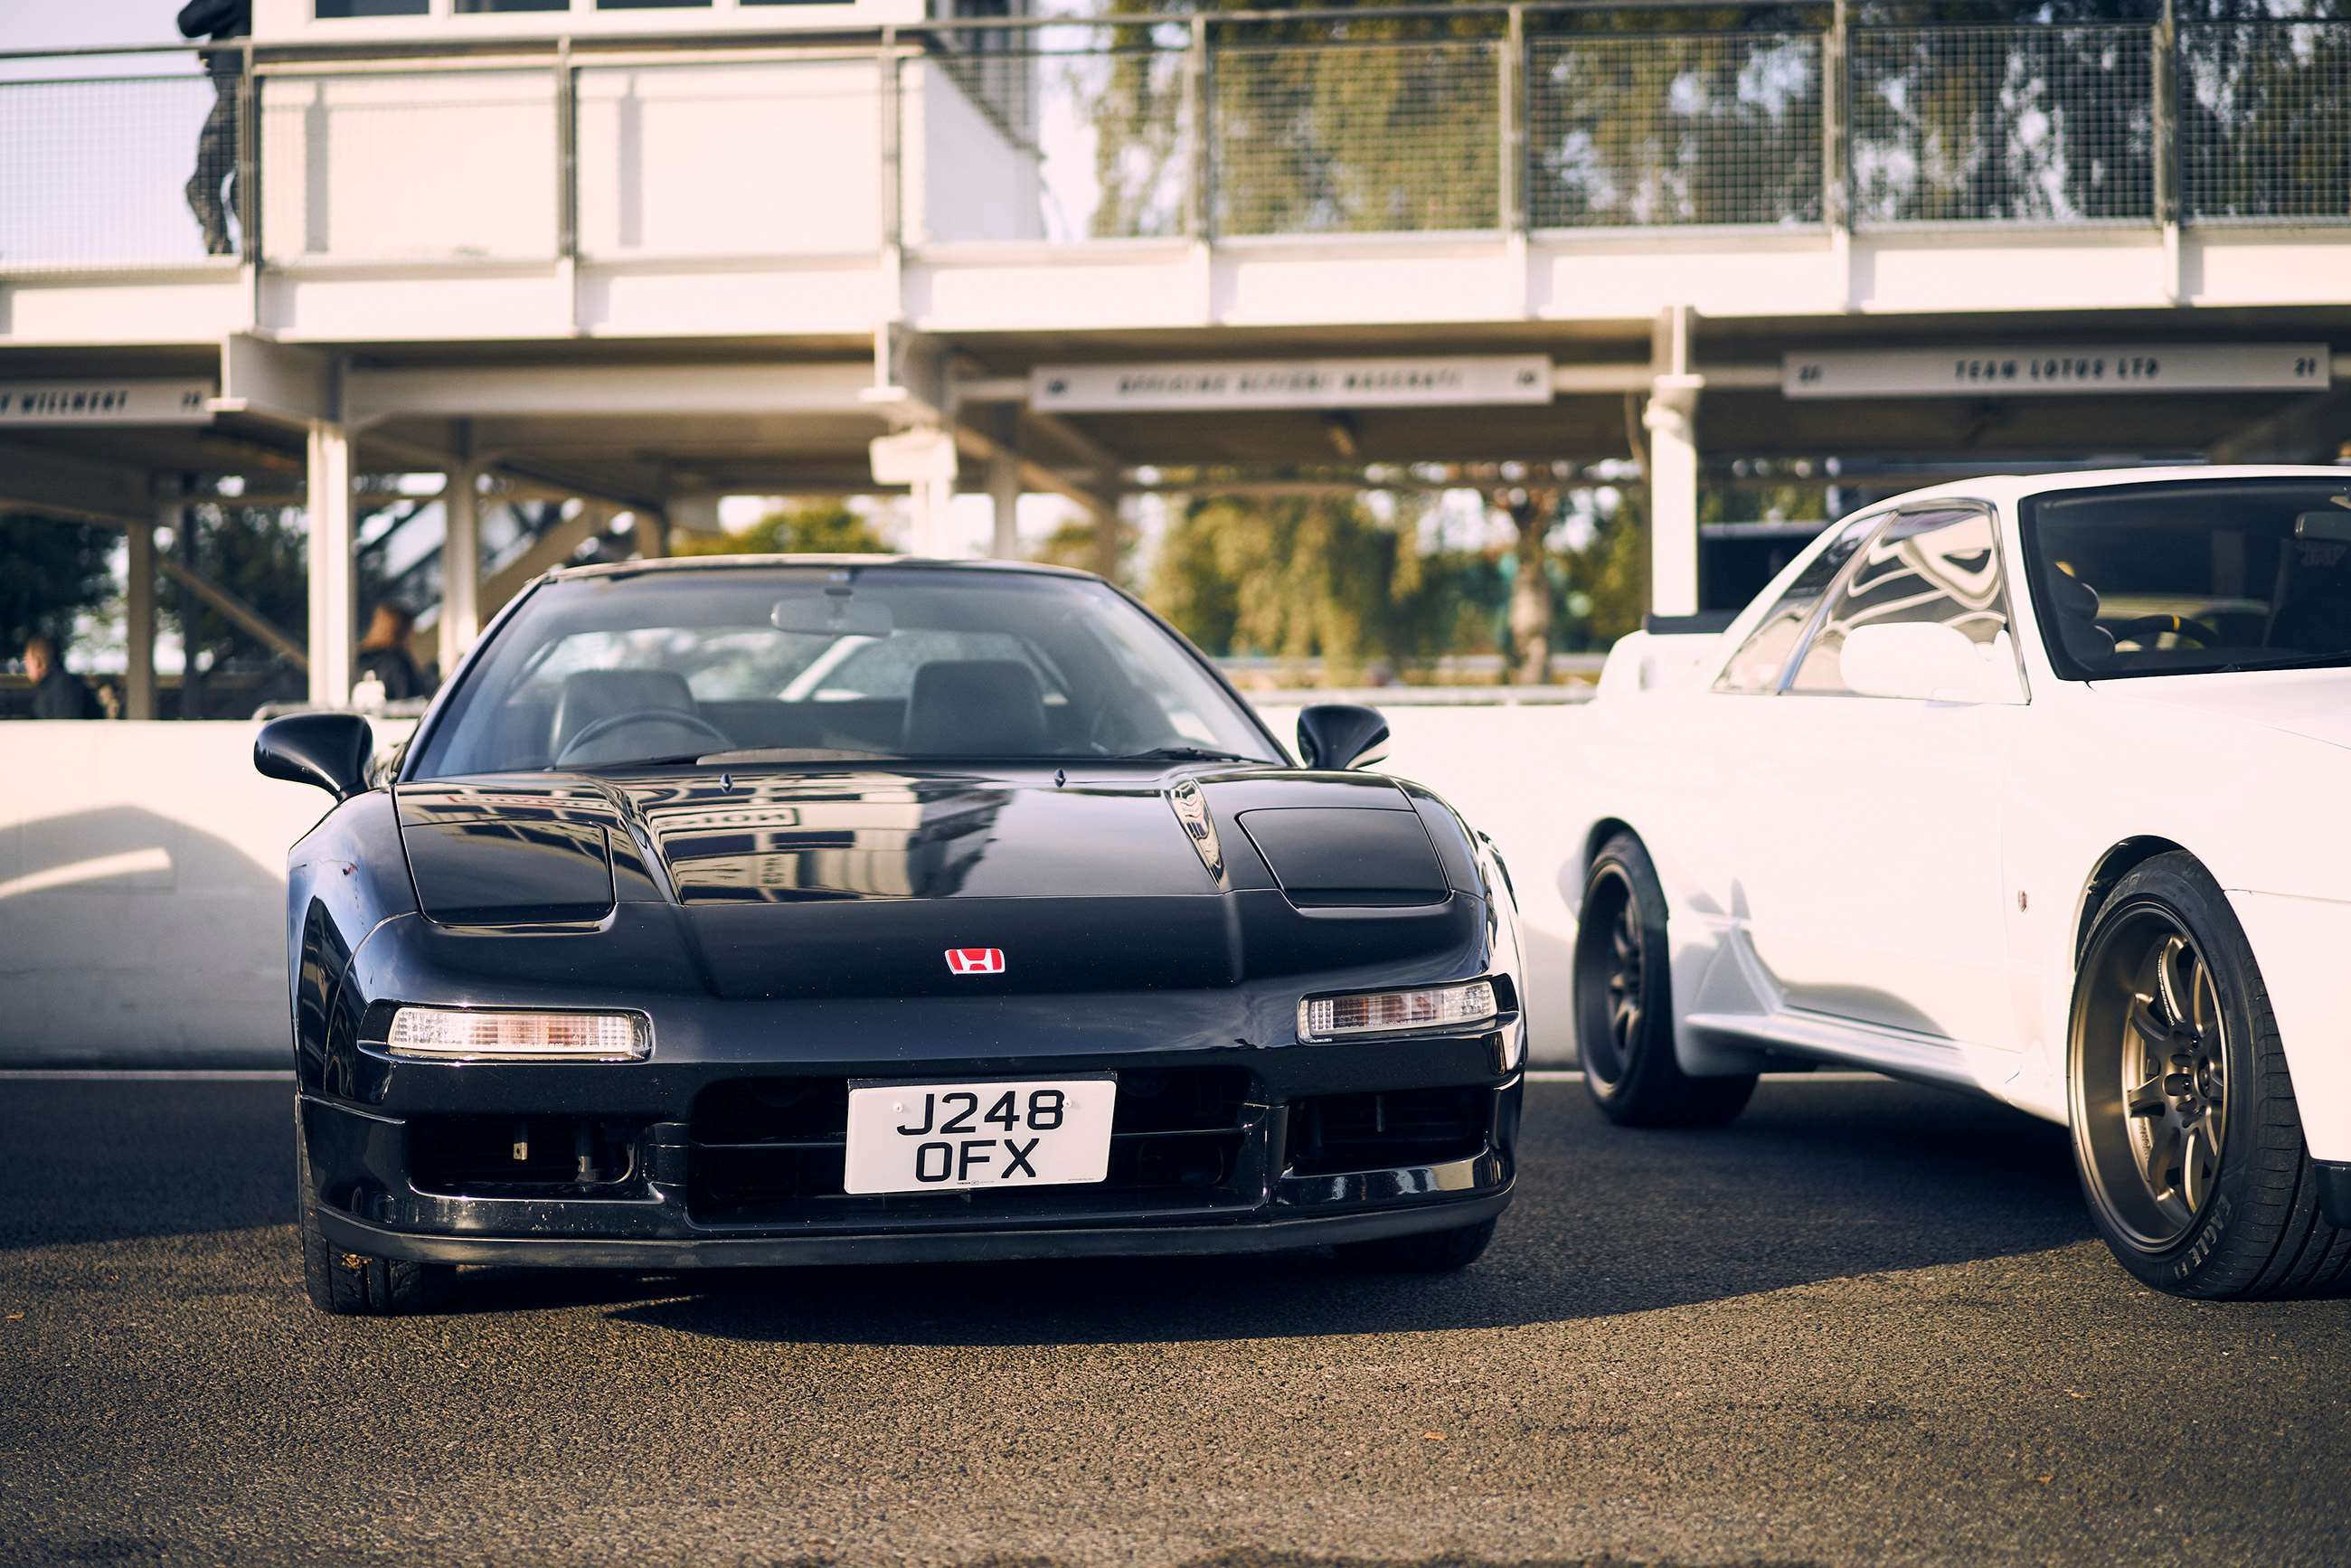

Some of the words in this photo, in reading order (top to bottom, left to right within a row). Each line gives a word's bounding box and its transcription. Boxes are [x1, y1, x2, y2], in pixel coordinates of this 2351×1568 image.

[1954, 359, 2017, 381] TEAM
[2030, 358, 2105, 381] LOTUS
[2117, 357, 2161, 378] LTD
[896, 1089, 1065, 1136] J248
[914, 1138, 1040, 1183] OFX
[2188, 1194, 2232, 1267] EAGLE
